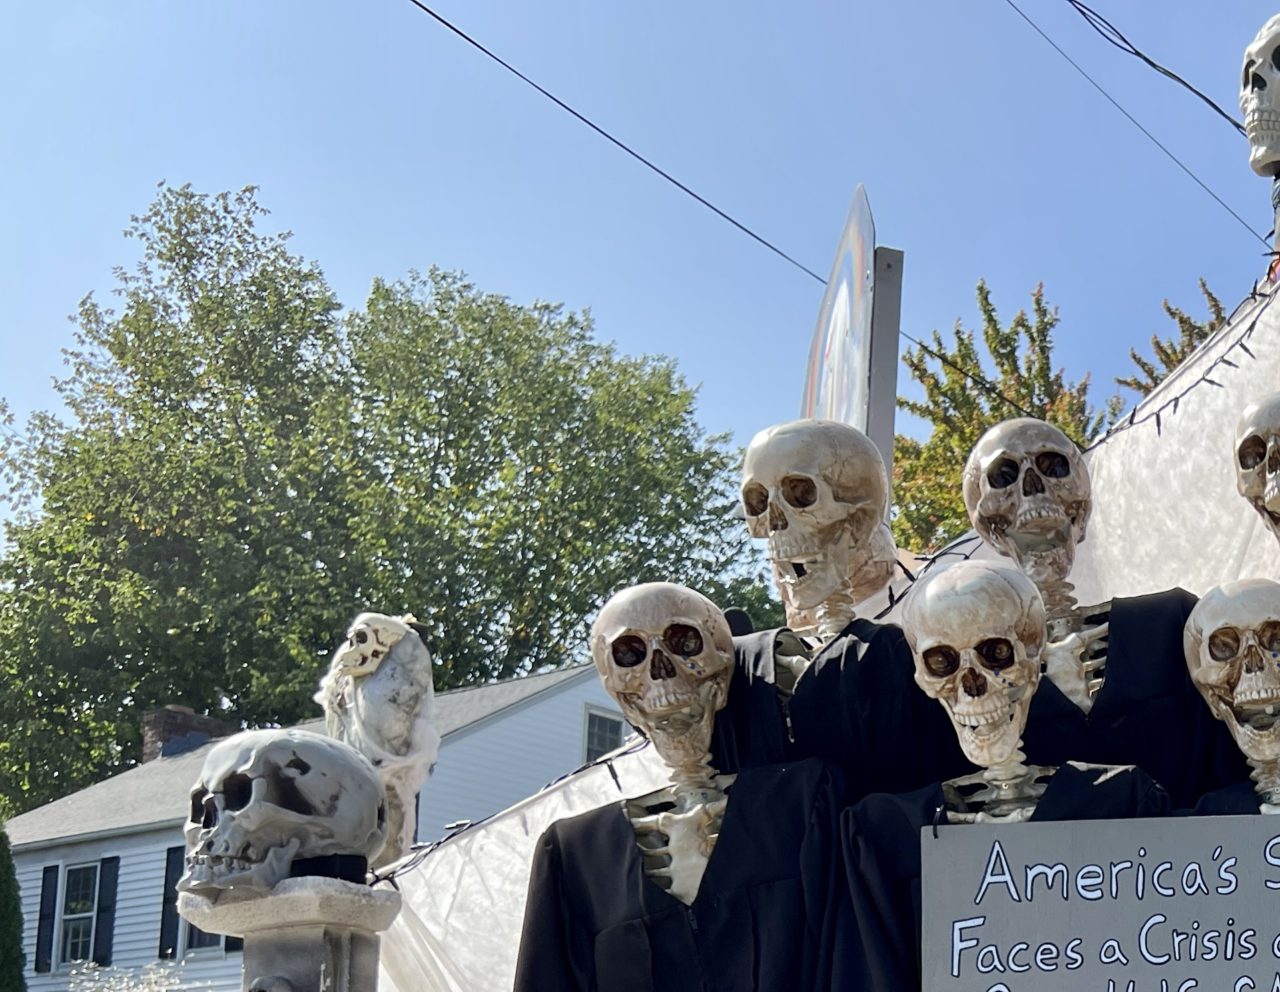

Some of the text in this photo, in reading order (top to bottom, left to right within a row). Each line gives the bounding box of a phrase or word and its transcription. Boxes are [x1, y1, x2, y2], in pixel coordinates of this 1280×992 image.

[975, 841, 1237, 904] America's
[952, 917, 1083, 977] Faces
[1100, 939, 1128, 965] a
[1139, 914, 1256, 964] Crisis
